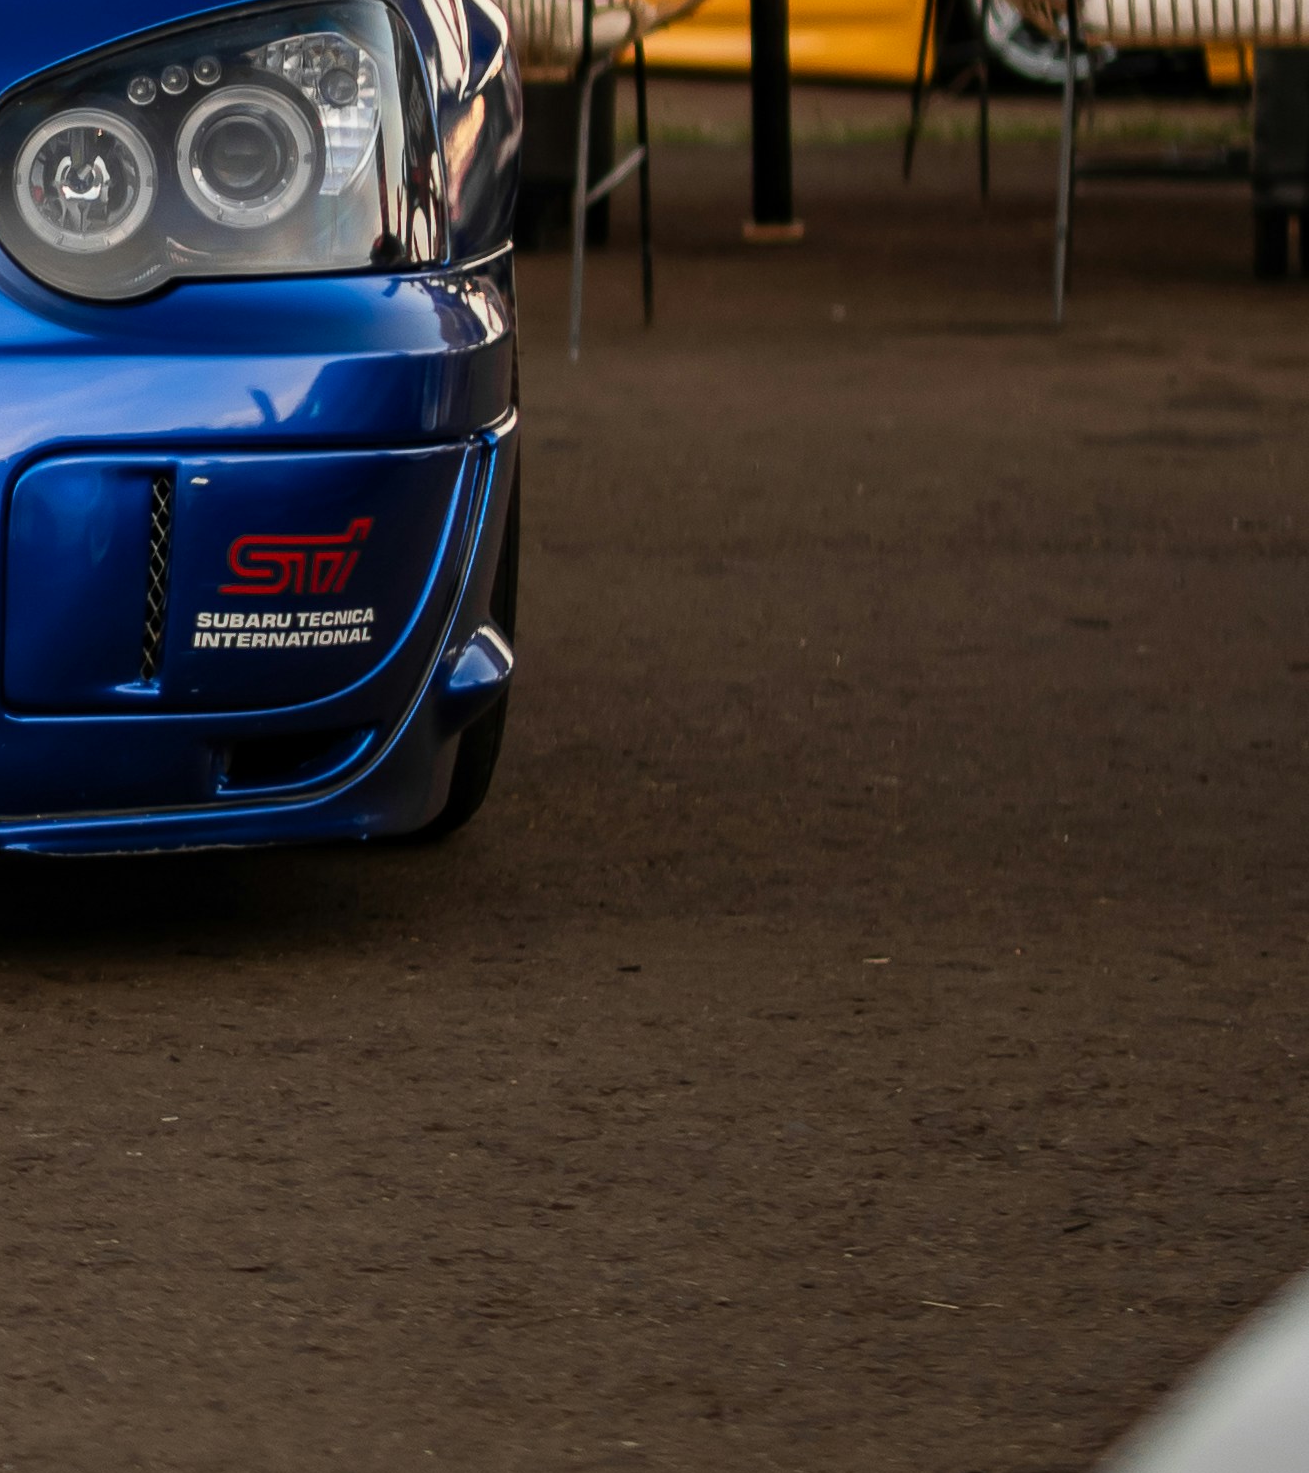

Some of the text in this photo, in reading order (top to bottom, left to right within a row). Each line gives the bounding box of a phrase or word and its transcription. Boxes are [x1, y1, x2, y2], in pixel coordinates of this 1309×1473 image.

[196, 607, 375, 629] SUBARU TECNICA
[192, 627, 373, 649] INTERNATIONAL
